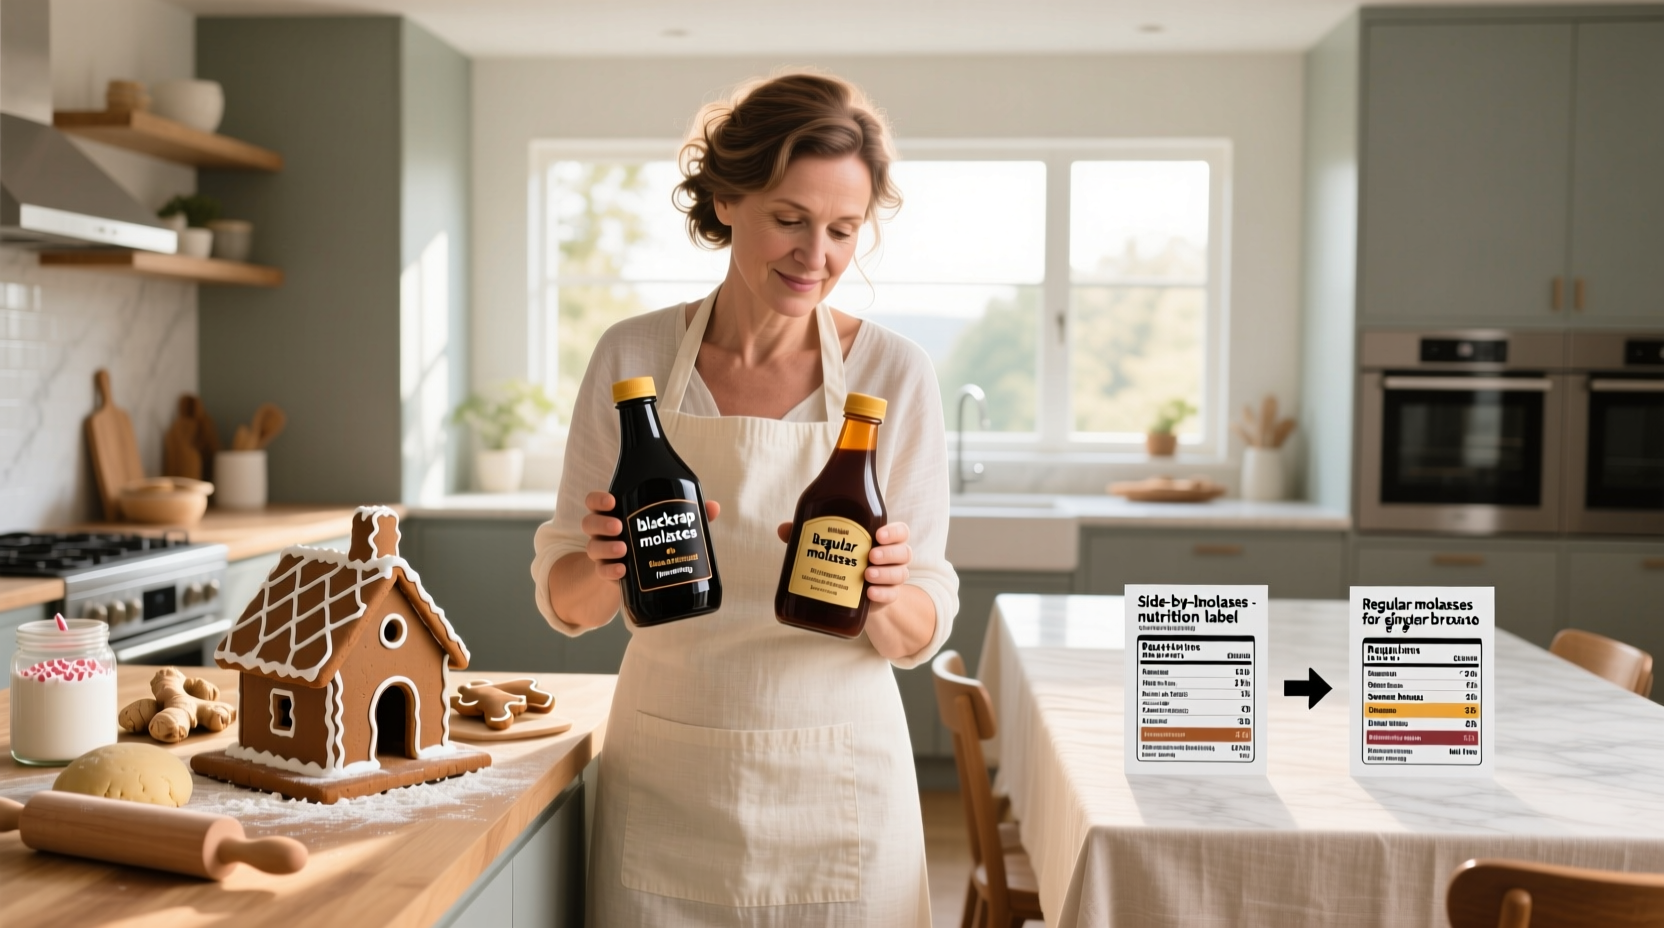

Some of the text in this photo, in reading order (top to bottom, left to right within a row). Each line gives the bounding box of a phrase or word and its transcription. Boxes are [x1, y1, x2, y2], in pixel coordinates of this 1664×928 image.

[1362, 597, 1412, 614] Regular
[1138, 609, 1238, 623] nutrition label
[1362, 612, 1380, 625] for
